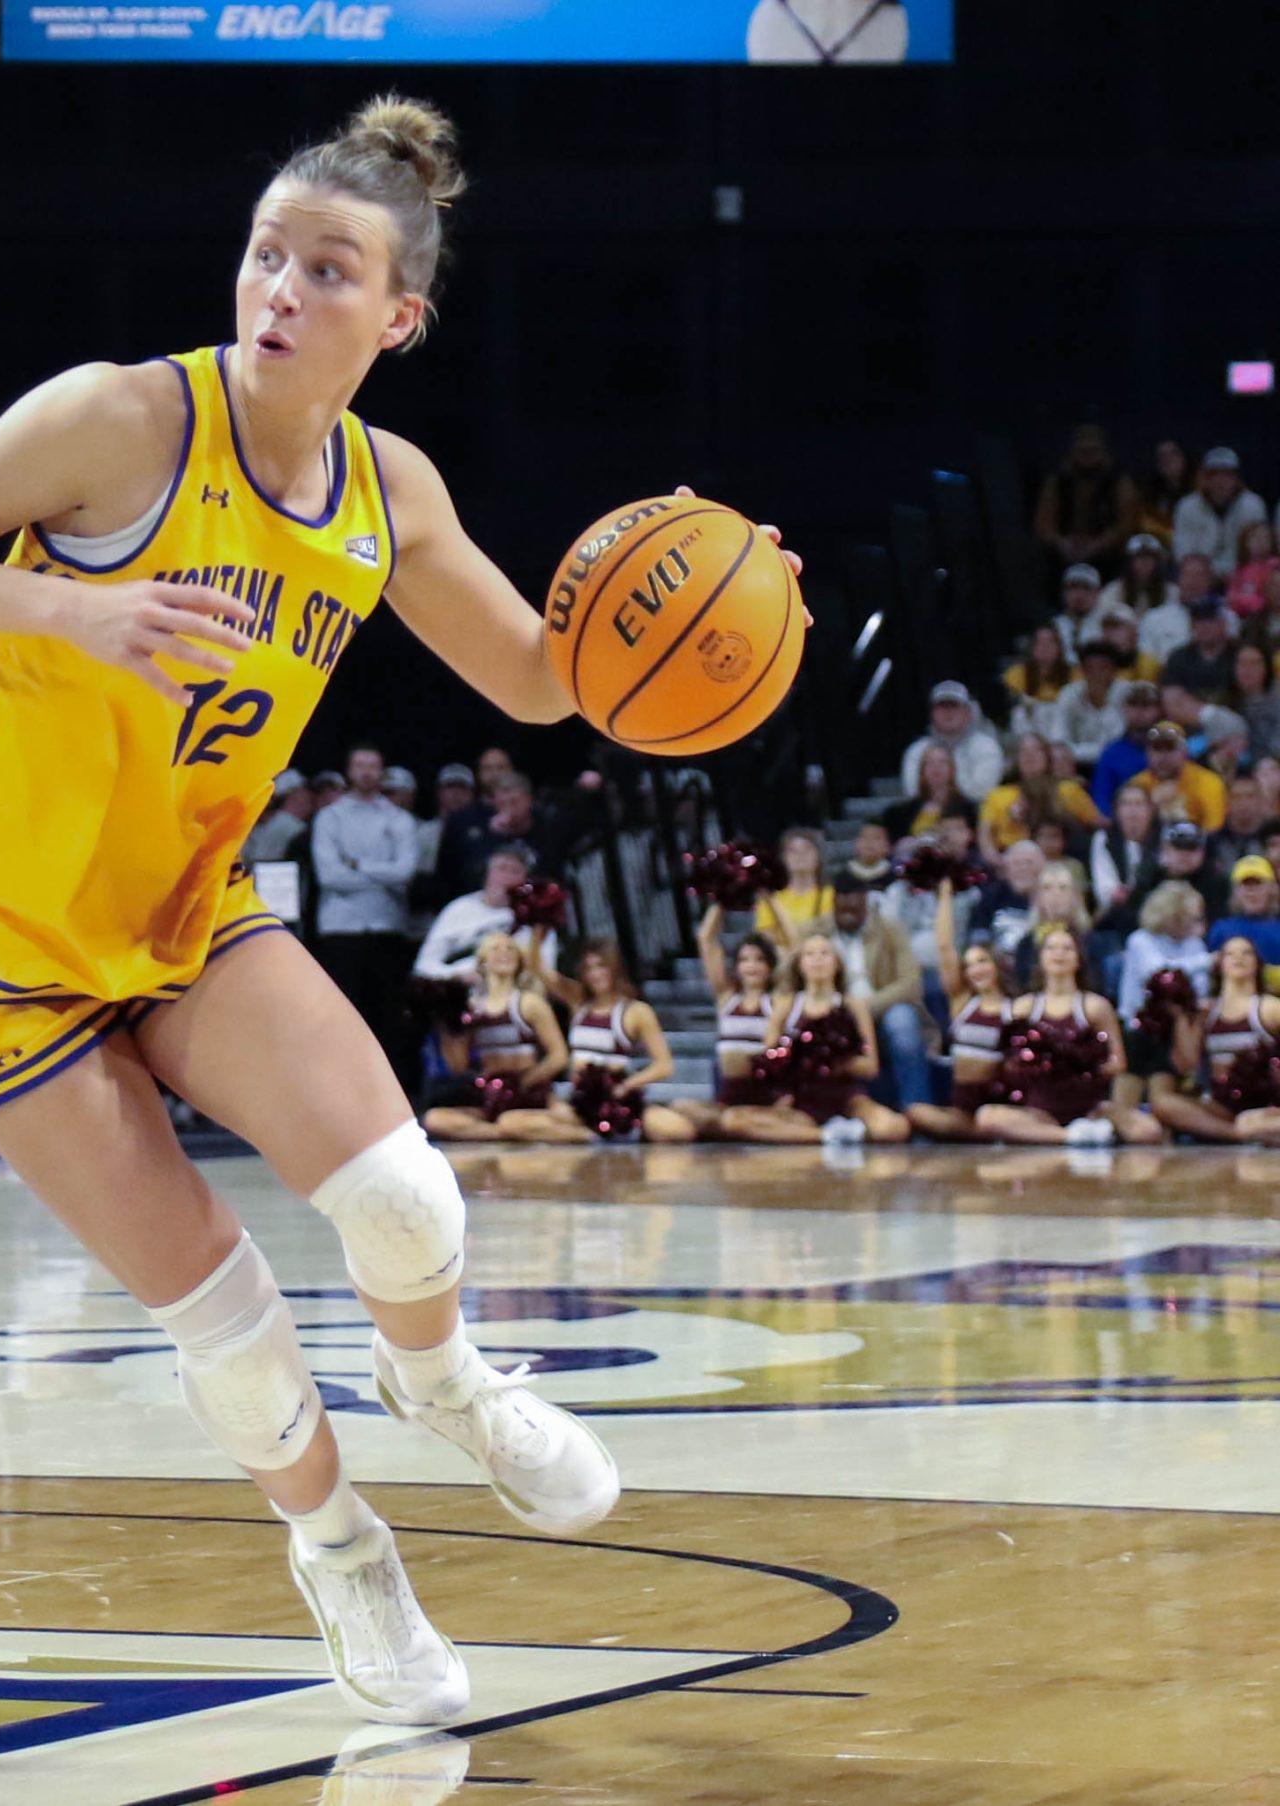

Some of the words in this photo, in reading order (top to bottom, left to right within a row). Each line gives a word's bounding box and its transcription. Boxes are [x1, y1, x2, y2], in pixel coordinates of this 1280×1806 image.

[216, 1, 391, 40] ENGAGE
[613, 547, 692, 648] EVO
[171, 679, 274, 767] 12
